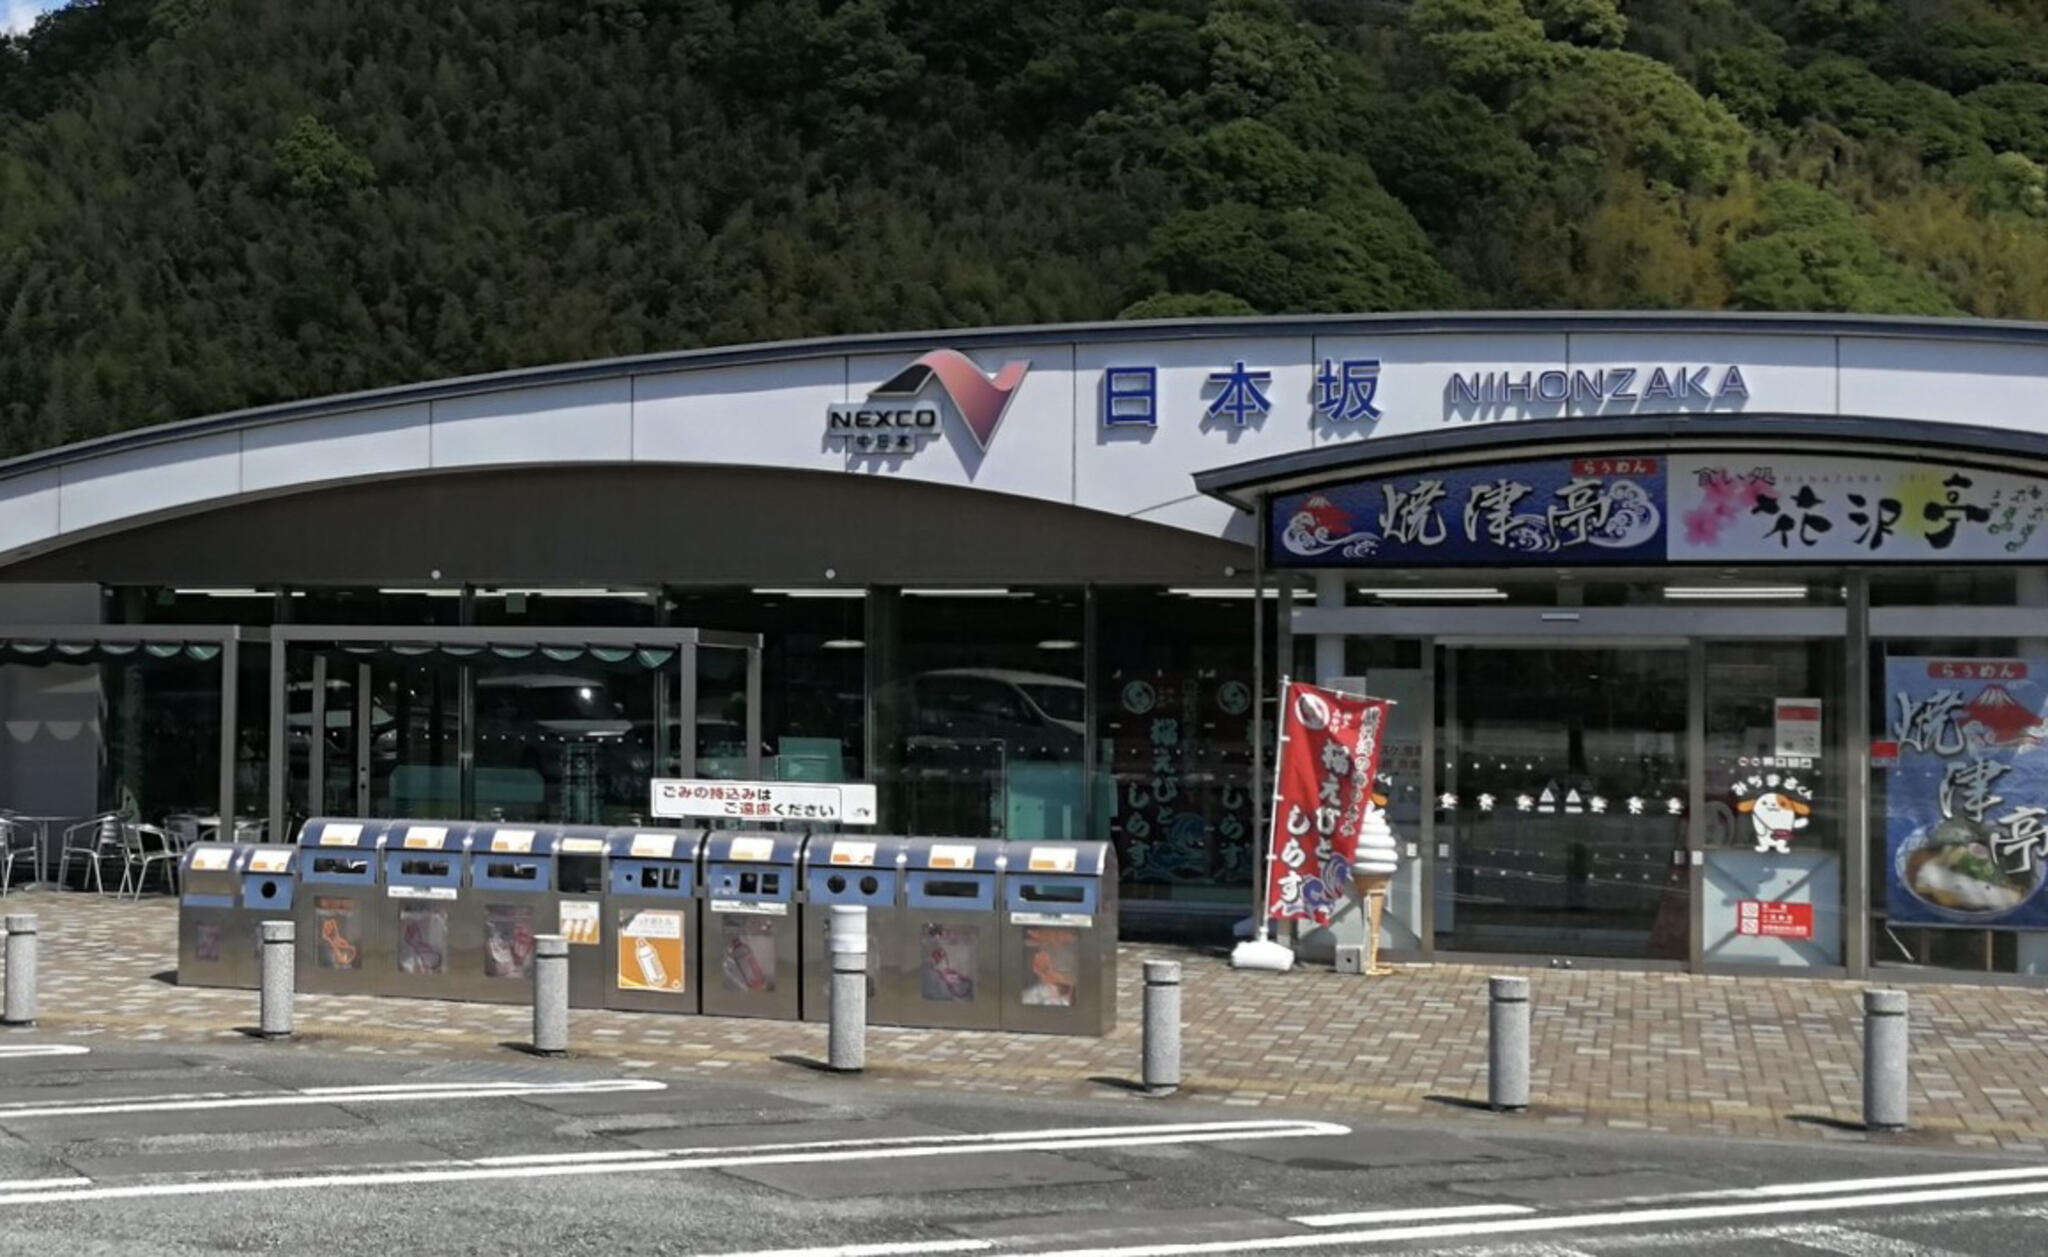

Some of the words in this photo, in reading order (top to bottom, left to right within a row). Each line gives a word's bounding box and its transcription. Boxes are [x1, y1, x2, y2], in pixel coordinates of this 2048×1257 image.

[1104, 357, 1383, 429] 日本坂
[1451, 364, 1750, 402] NIHONZAKA
[831, 409, 936, 429] NEXCO
[1379, 477, 1610, 548] 焼津亭
[1752, 474, 1990, 550] 花沢亭
[663, 786, 772, 801] ごみの持込みは
[724, 801, 834, 817] ご遠慮ください
[1895, 689, 2048, 875] 焼津亭
[1126, 781, 1151, 868] しらす
[1277, 805, 1311, 903] しらす
